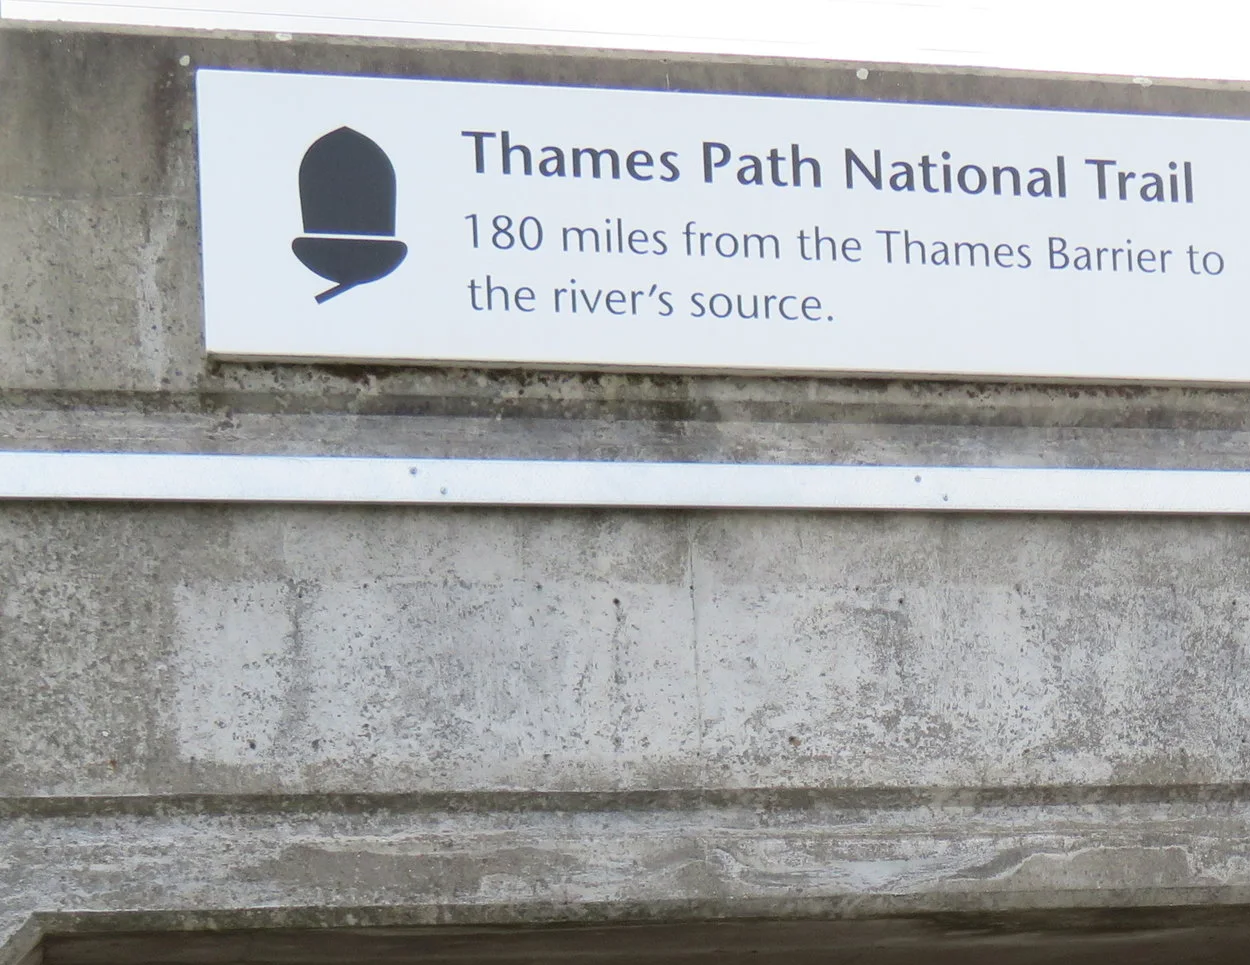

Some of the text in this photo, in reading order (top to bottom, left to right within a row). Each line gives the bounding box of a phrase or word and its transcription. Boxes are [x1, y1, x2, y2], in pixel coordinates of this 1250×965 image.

[461, 130, 1193, 203] Thames Path National Trail
[465, 213, 1224, 275] 180 miles from the Thames Barrier to
[467, 274, 834, 322] the river's source.
